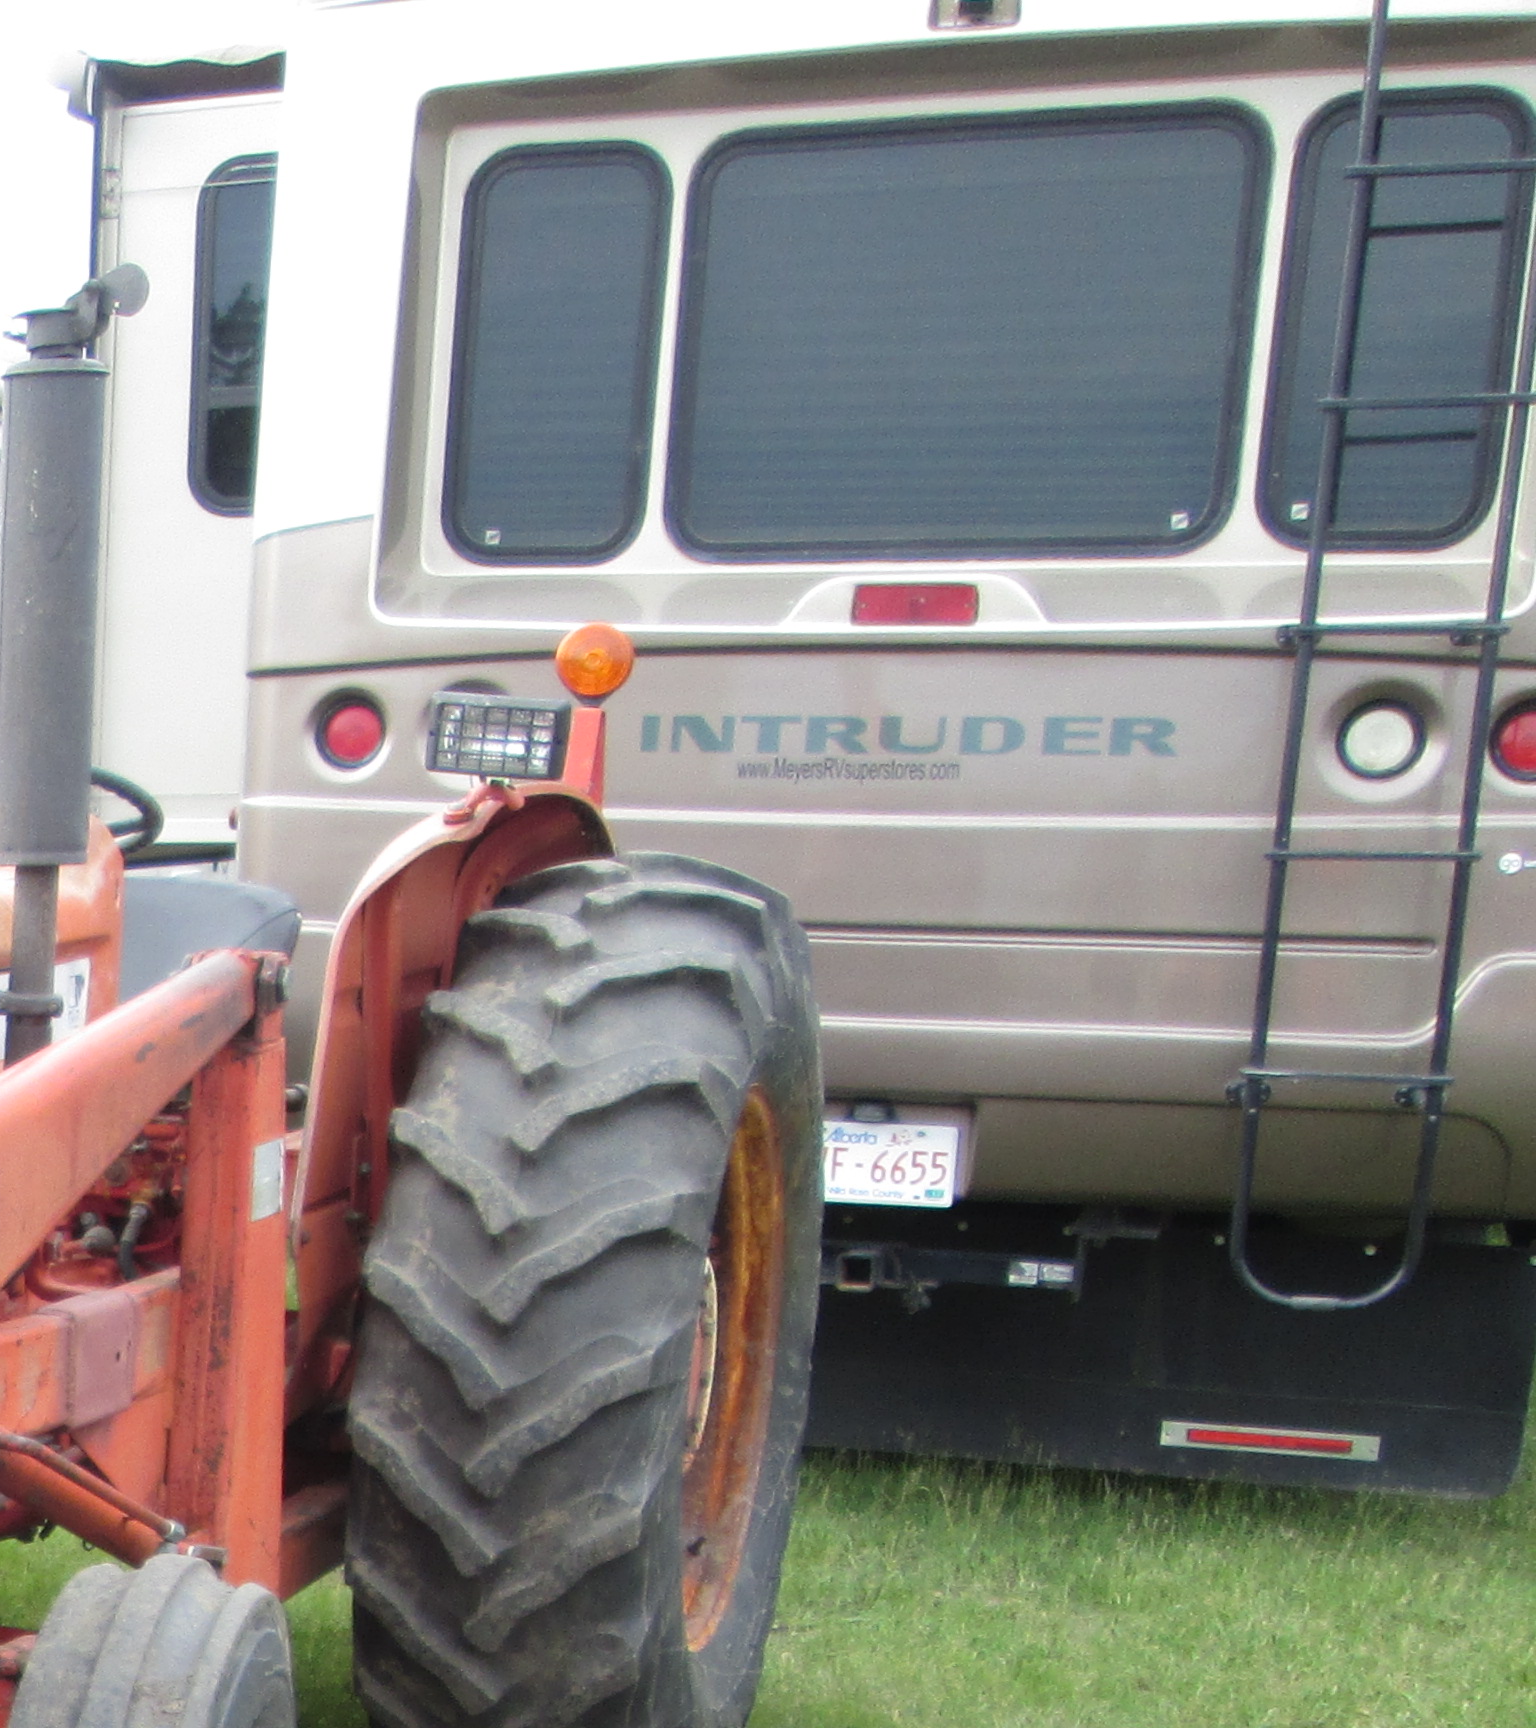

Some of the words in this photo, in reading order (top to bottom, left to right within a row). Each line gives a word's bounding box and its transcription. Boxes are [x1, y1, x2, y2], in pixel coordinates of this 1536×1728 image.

[640, 715, 1179, 757] INTRUDER
[737, 757, 961, 785] www.MeyersRVsuperstores.com
[822, 1147, 949, 1187] F-6655
